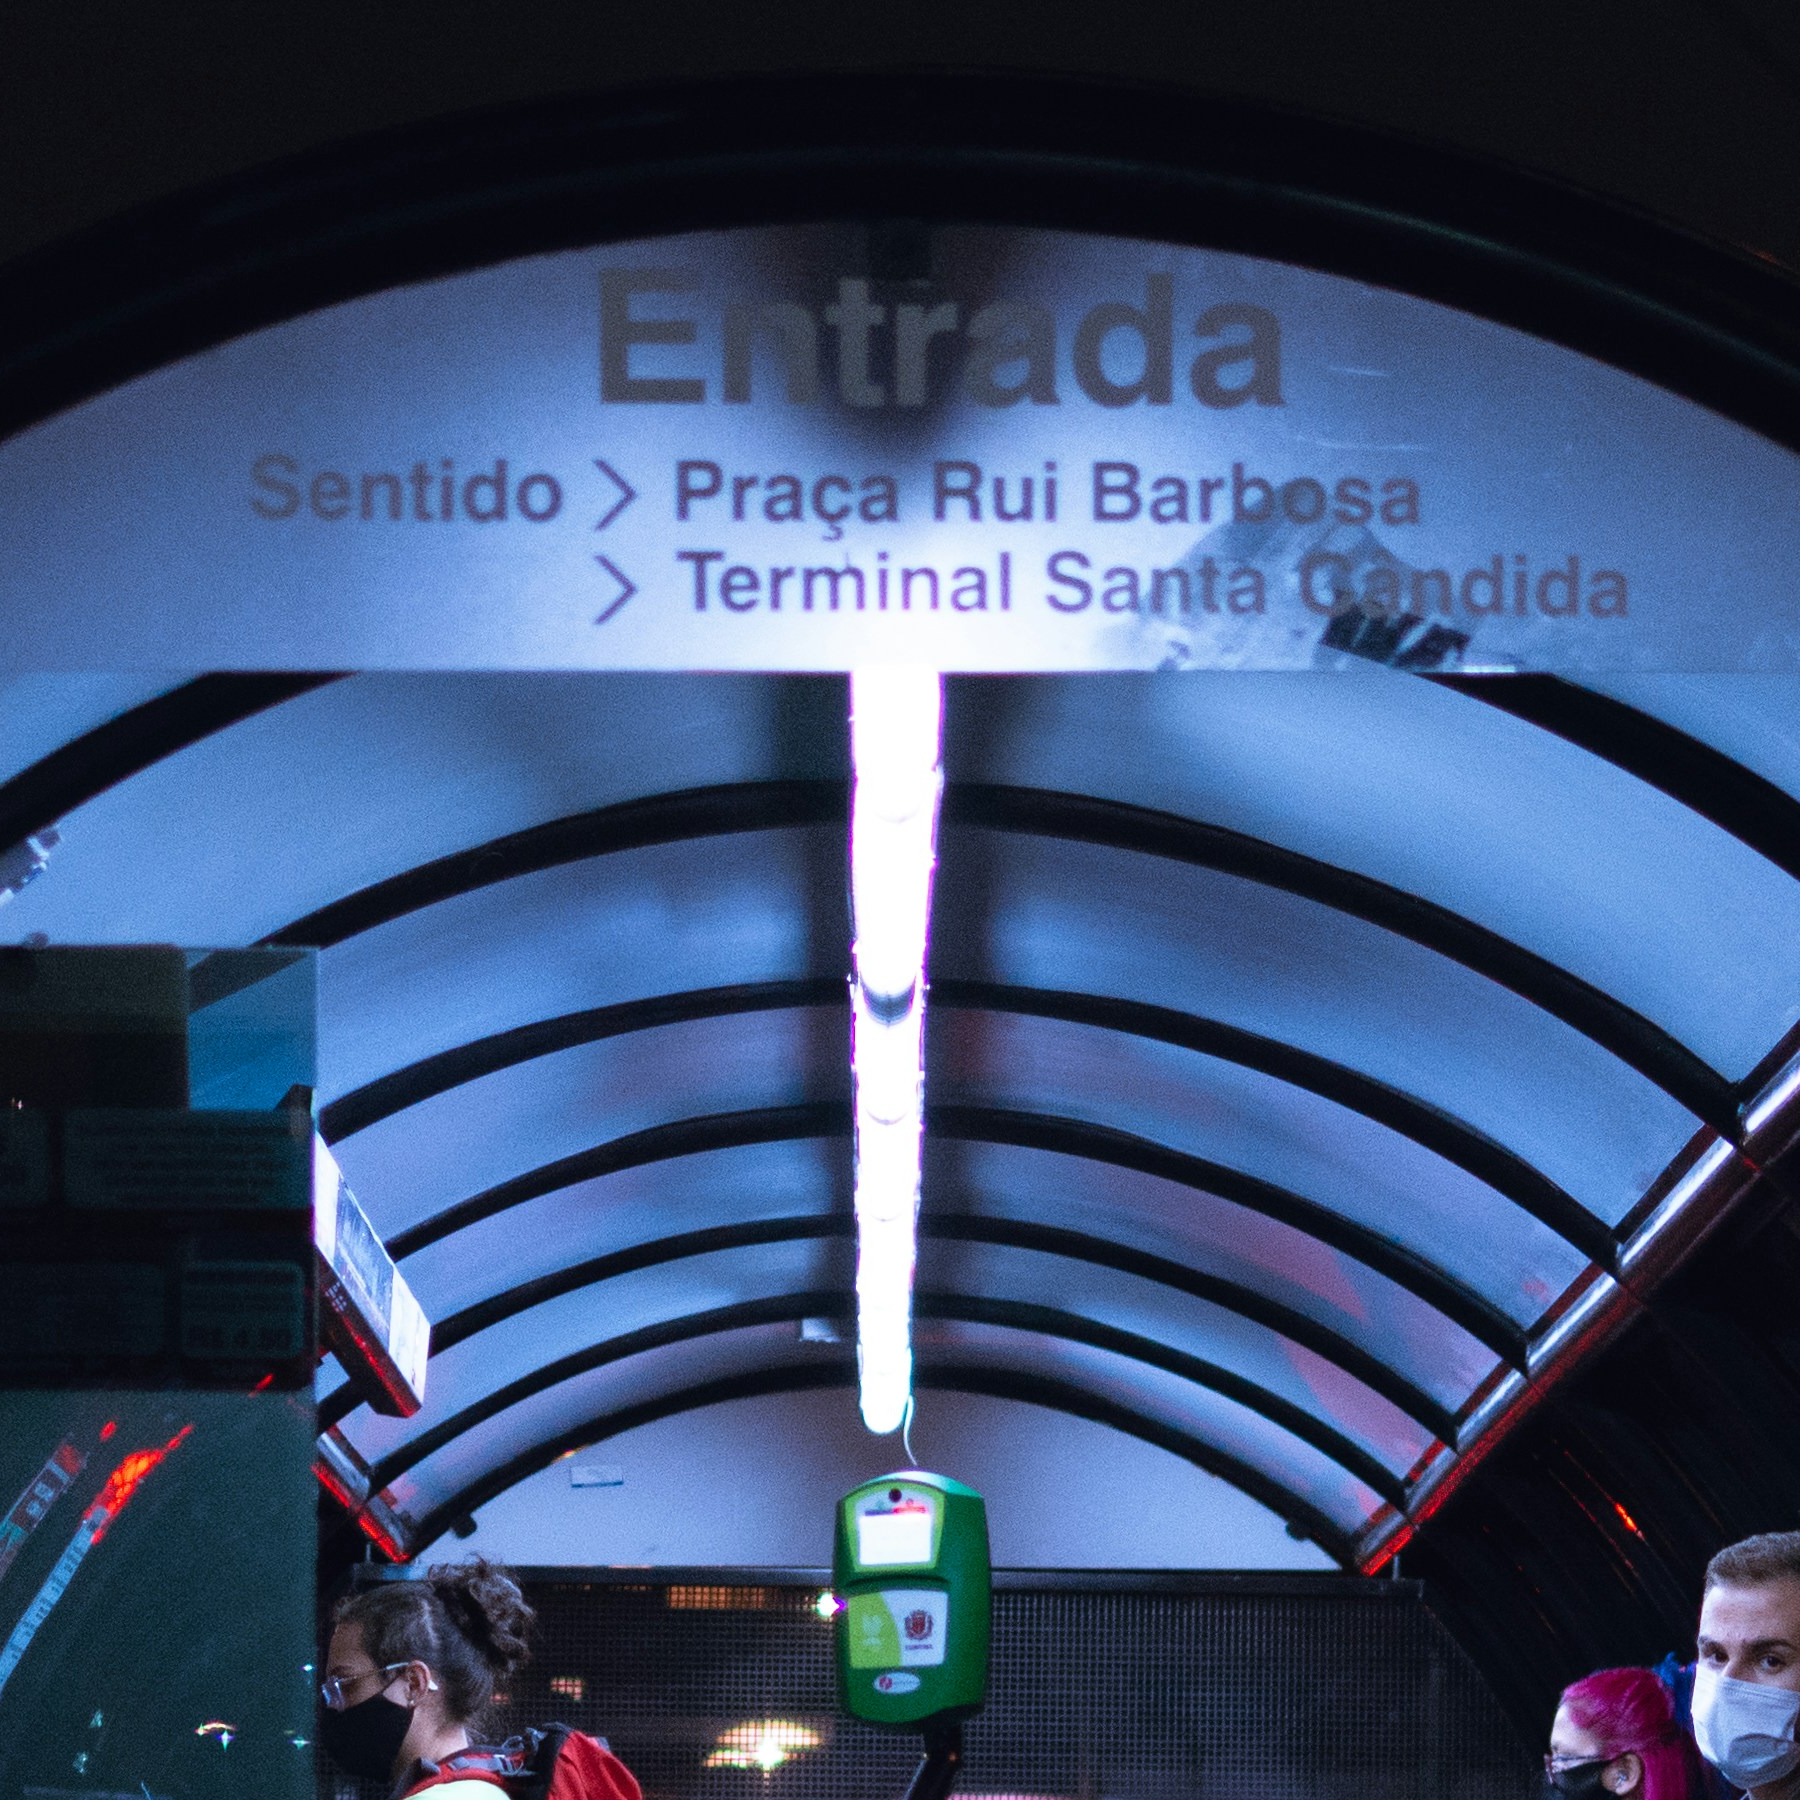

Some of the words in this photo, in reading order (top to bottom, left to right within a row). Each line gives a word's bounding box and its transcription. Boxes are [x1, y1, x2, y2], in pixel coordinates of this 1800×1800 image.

[596, 265, 1286, 410] Entrada
[250, 456, 563, 524] Sentido
[675, 459, 897, 540] Praça
[933, 459, 1057, 524] Rui
[1092, 459, 1421, 526] Barbosa
[675, 550, 1012, 614] Terminal
[1045, 551, 1267, 618] Santa
